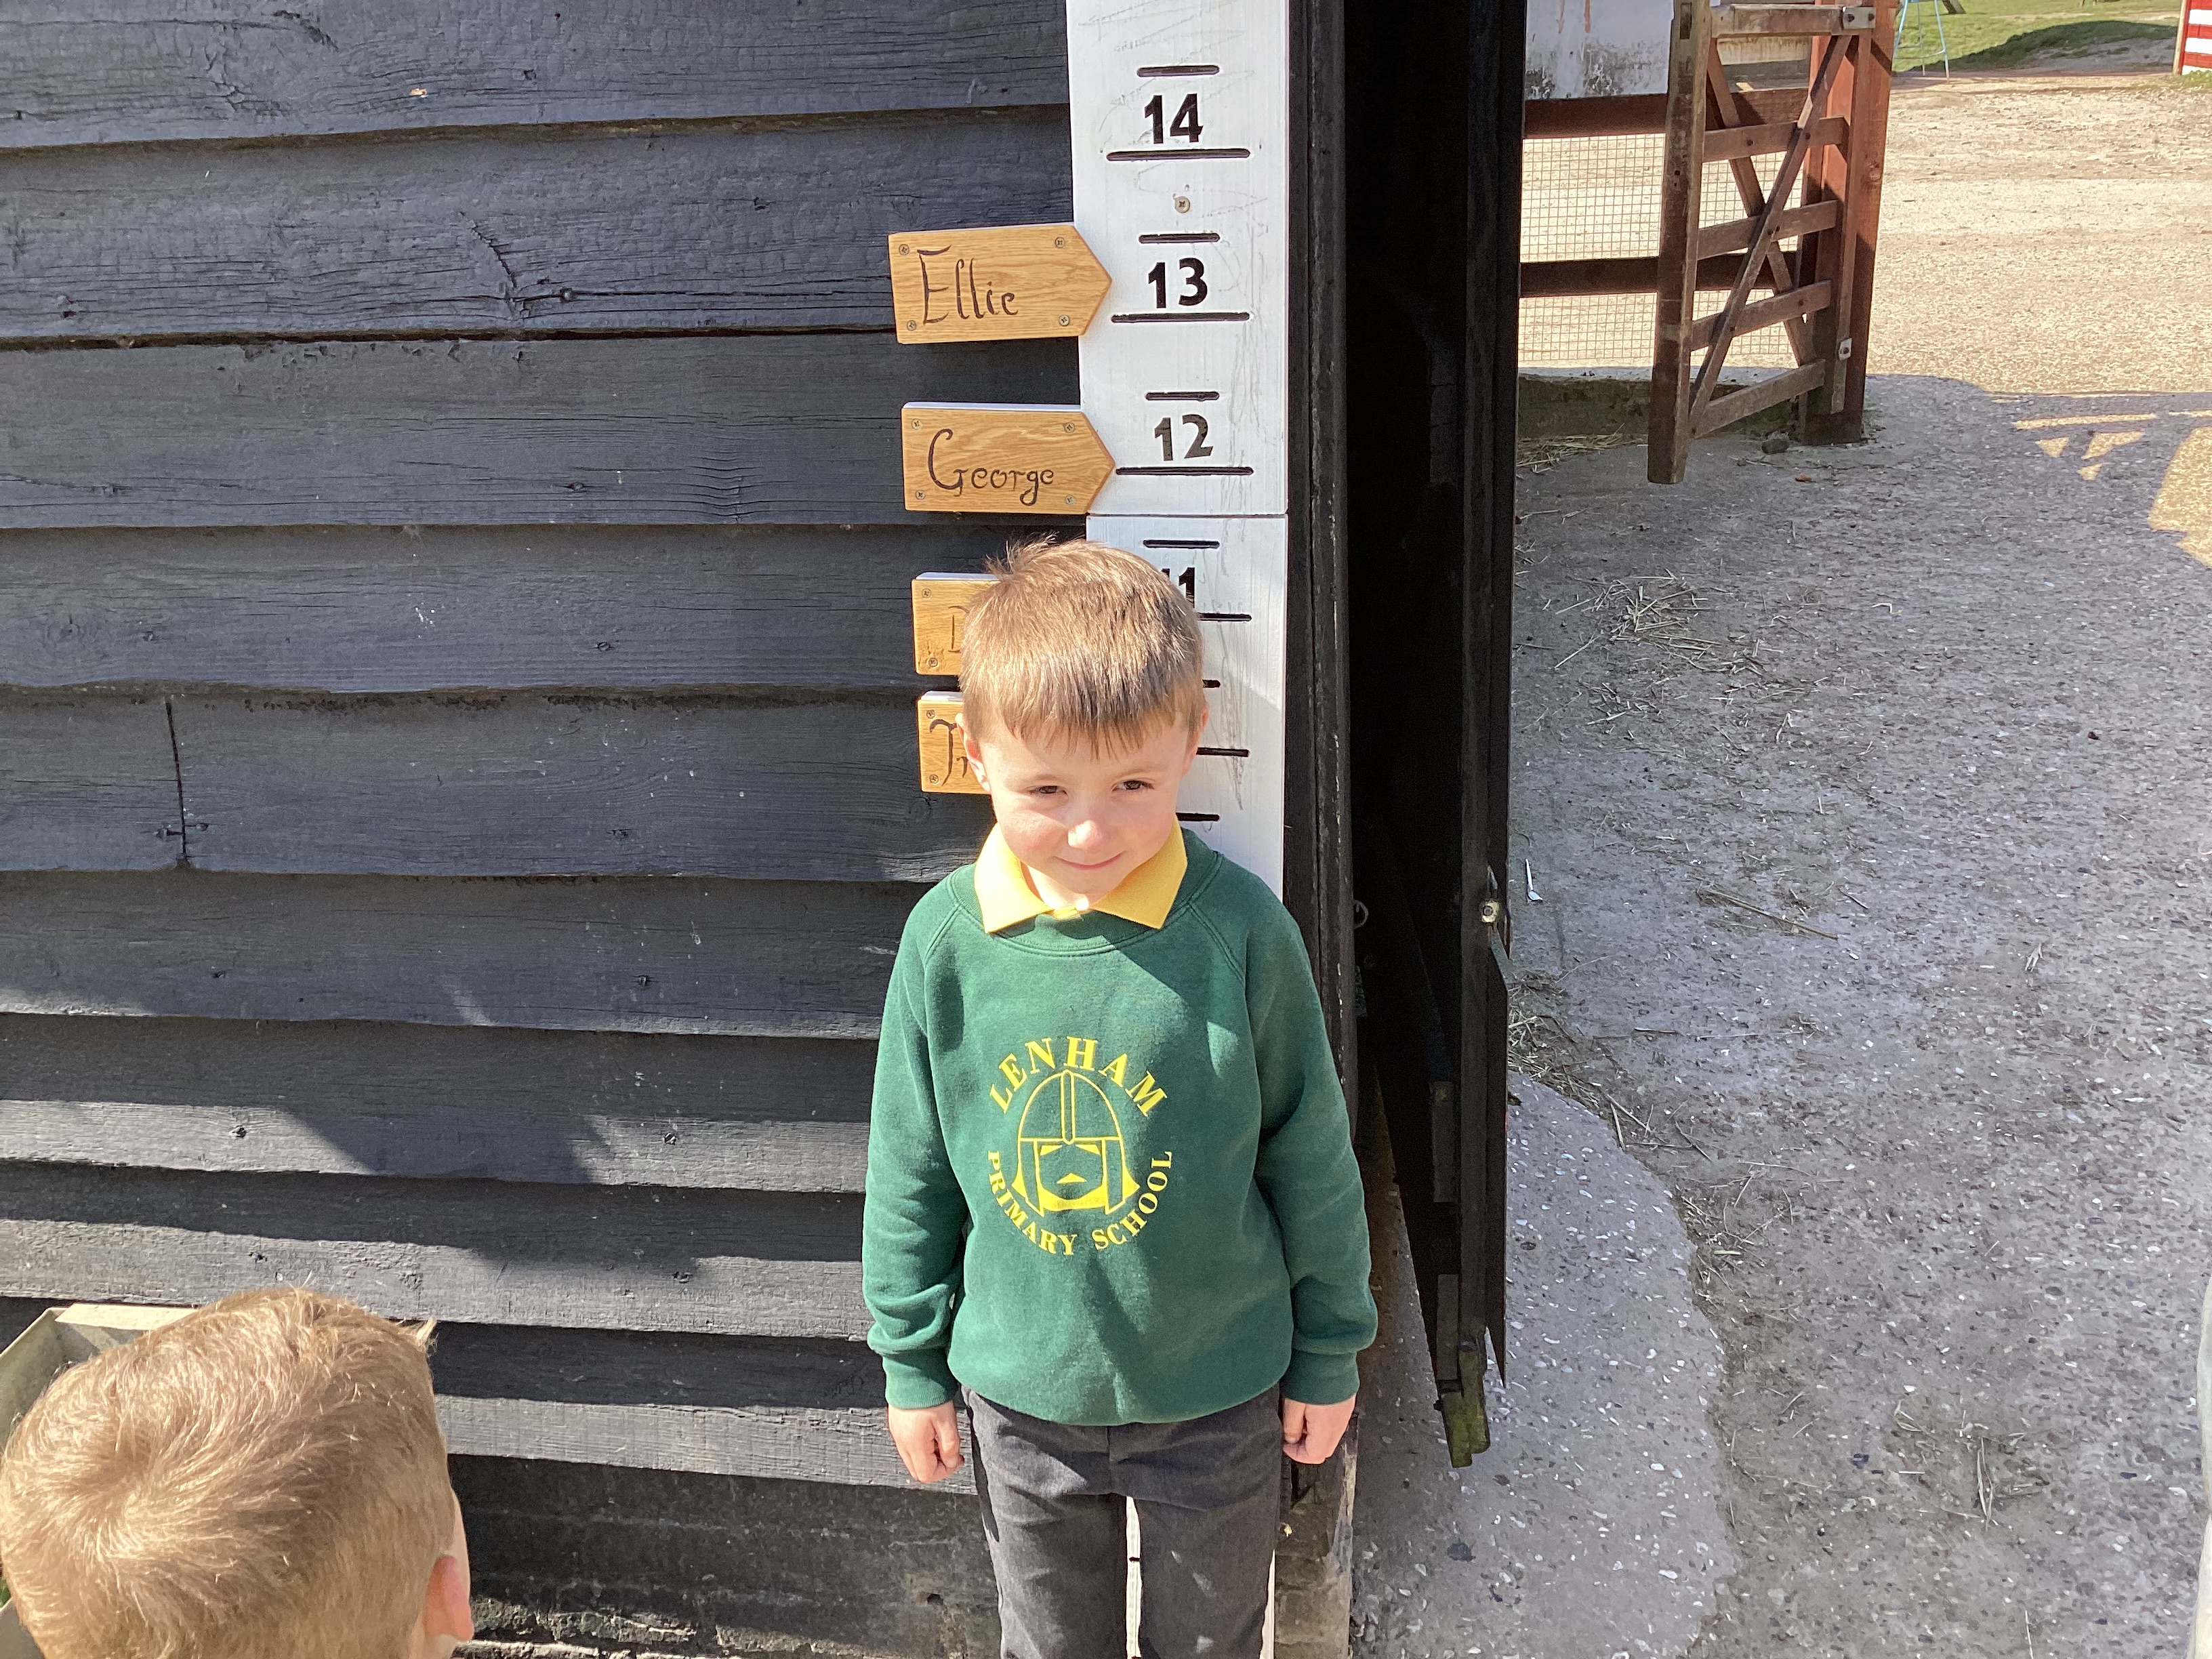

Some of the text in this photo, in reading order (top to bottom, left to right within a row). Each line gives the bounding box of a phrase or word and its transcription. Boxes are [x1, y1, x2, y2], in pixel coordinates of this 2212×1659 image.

[1144, 93, 1204, 144] 14
[916, 244, 1019, 326] Ellie
[1148, 258, 1208, 309] 13
[927, 428, 1054, 506] George
[1154, 413, 1214, 462] 12
[1160, 566, 1195, 609] 1
[989, 1036, 1168, 1117] LENHAM
[987, 1150, 1172, 1256] PRIMARY SCHOOL
